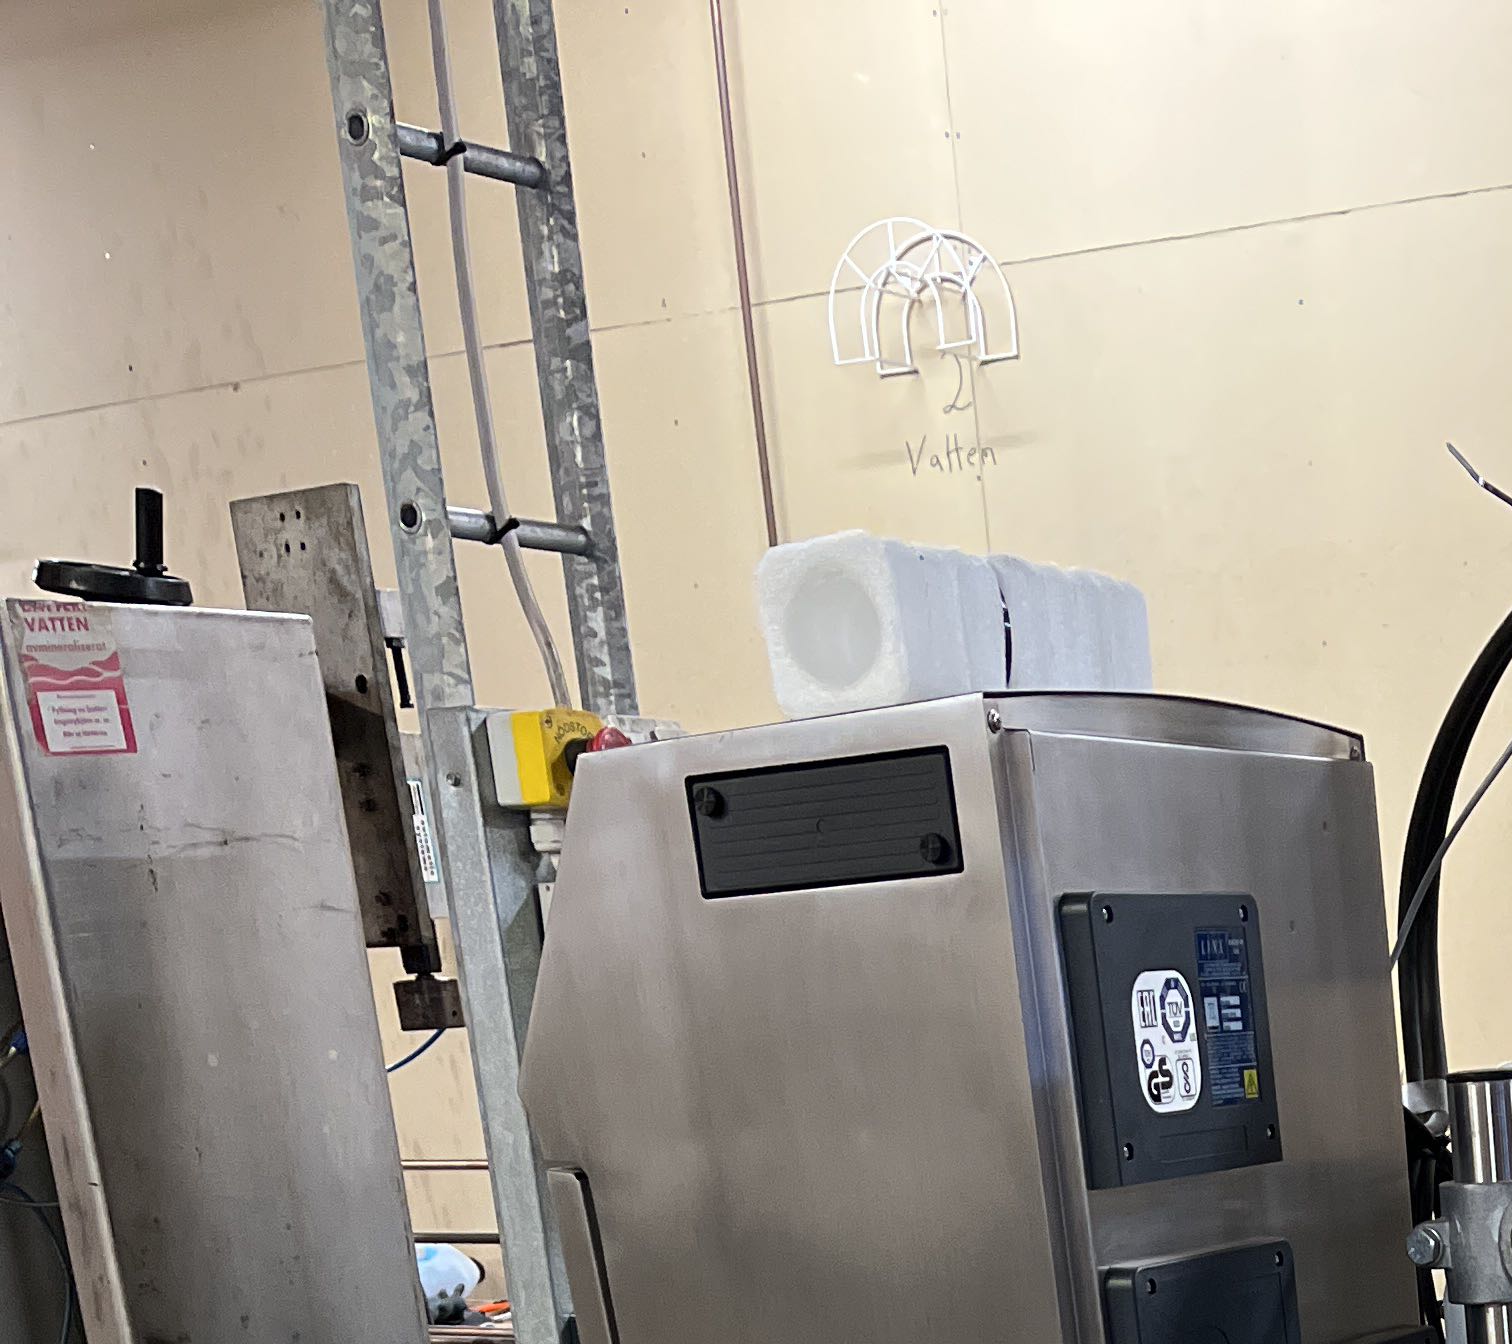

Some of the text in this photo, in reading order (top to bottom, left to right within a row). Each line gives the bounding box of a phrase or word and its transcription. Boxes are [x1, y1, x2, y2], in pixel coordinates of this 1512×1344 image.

[941, 351, 974, 414] 2
[905, 432, 998, 477] Vatten
[25, 617, 89, 632] VATTEN
